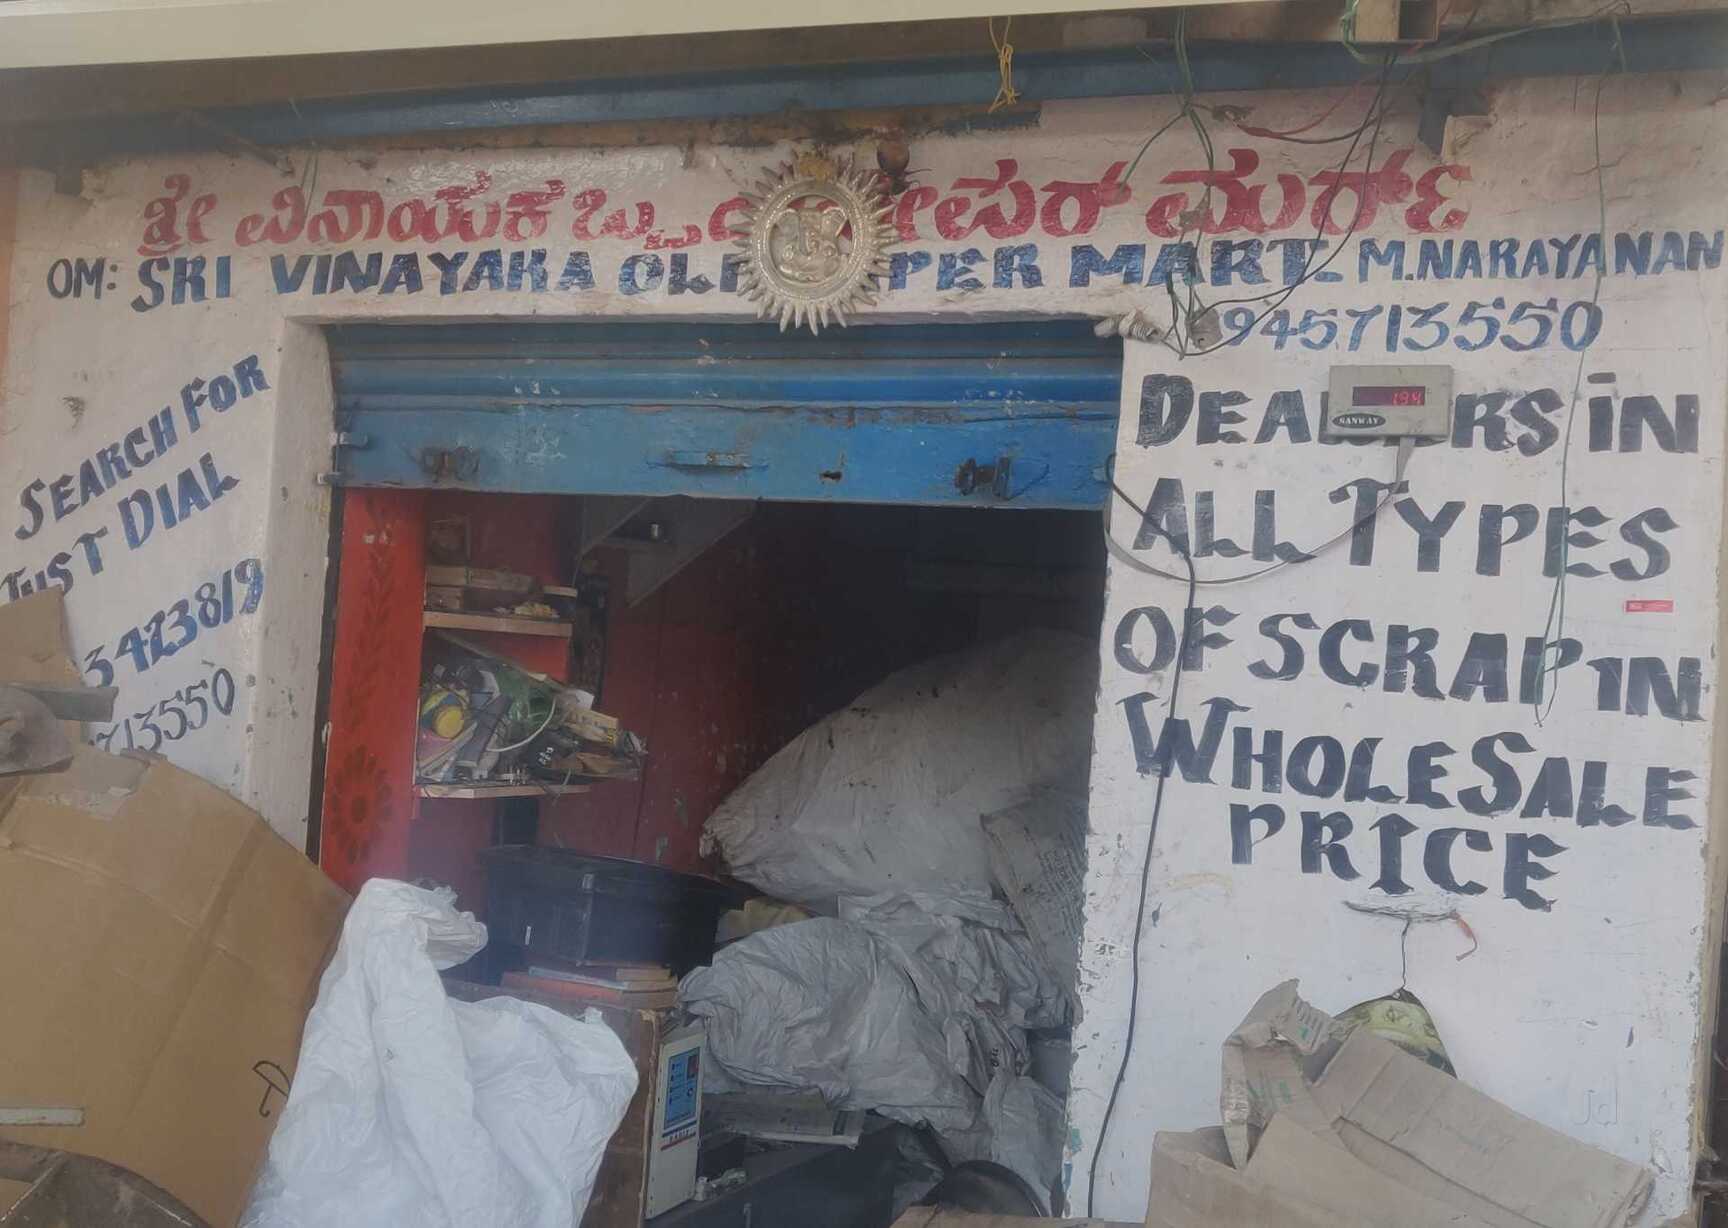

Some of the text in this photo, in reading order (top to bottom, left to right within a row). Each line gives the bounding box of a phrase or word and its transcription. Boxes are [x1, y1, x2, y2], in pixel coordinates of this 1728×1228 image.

[131, 256, 232, 312] SRI
[271, 250, 595, 296] VINAYAKA
[14, 354, 272, 540] SEARCH FOR
[117, 452, 241, 550] DIAL
[1132, 478, 1680, 581] ALL TYPES
[1113, 605, 1240, 675] OF
[1247, 613, 1583, 705] SCRAP
[1115, 692, 1701, 831] WHOLESALE
[1230, 803, 1568, 912] PRICE
